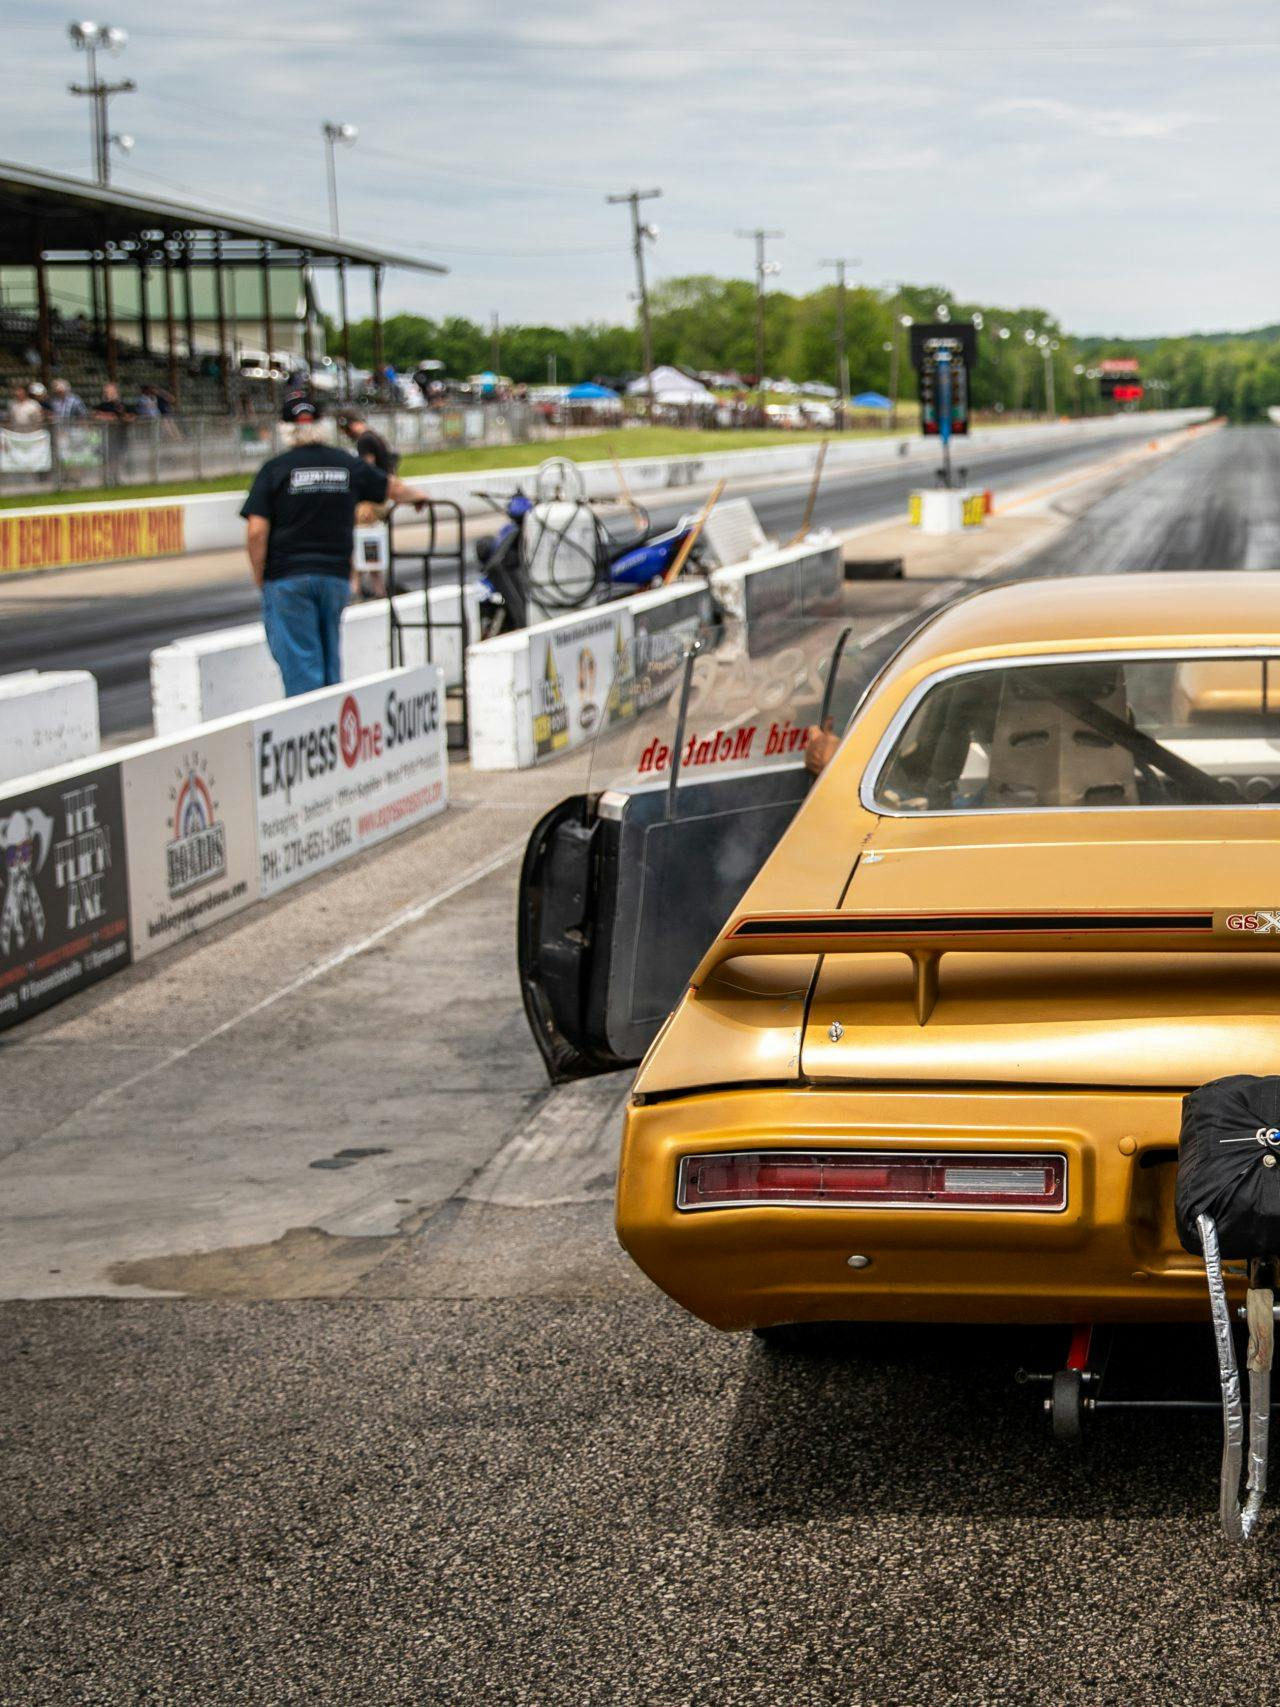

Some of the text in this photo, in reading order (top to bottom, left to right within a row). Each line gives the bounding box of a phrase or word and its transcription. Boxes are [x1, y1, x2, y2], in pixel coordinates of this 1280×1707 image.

[259, 729, 337, 804] Express
[340, 695, 383, 768] One
[386, 690, 438, 748] Source
